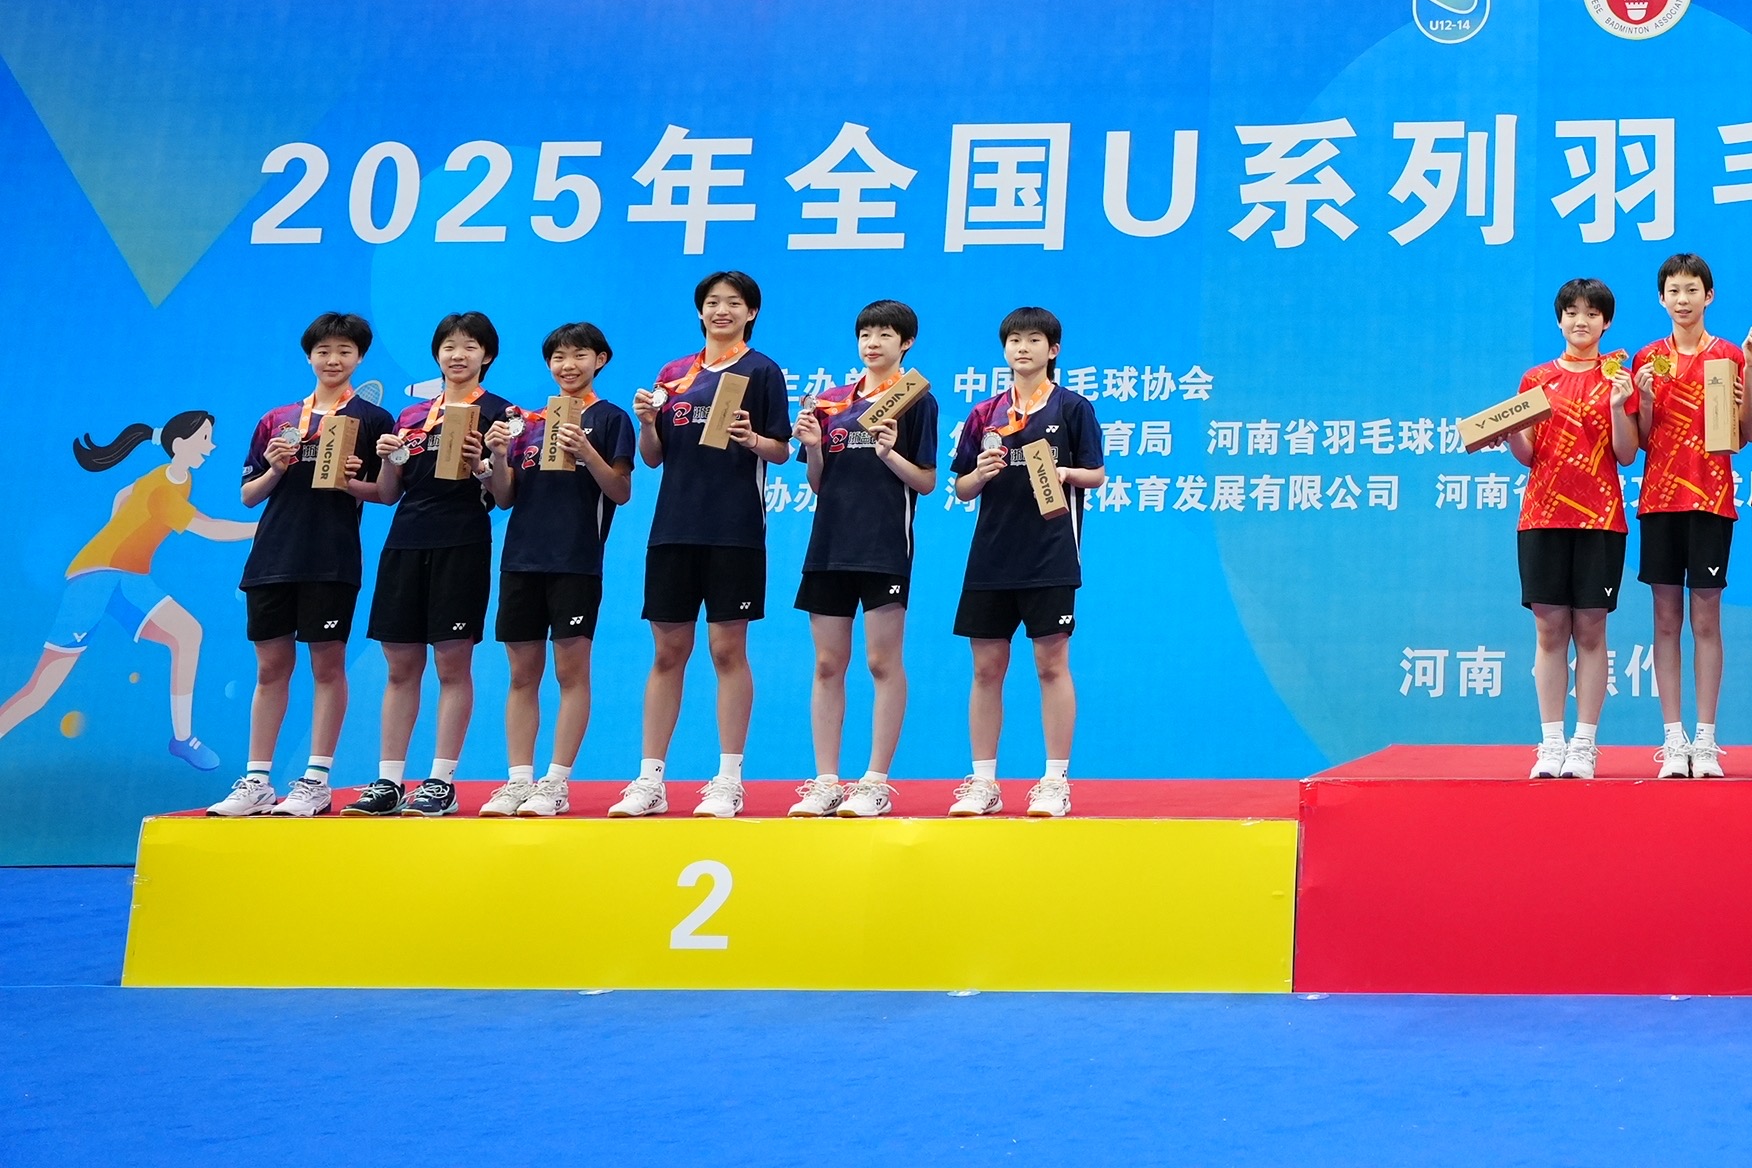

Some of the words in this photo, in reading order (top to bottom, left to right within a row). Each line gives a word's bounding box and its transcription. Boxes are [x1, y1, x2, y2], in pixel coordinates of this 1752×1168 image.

[1429, 19, 1471, 32] U12-14
[1605, 16, 1650, 34] BADMINTON
[953, 365, 1214, 403] 中国毛球协会
[869, 392, 905, 424] VICTOR
[1489, 401, 1531, 423] VICTOR
[548, 420, 560, 463] VICTOR
[1206, 418, 1508, 456] 河南省羽毛球协
[320, 439, 335, 480] VICTOR
[1037, 463, 1055, 505] VICTOR
[1399, 644, 1506, 699] 河南
[669, 858, 734, 951] 2
